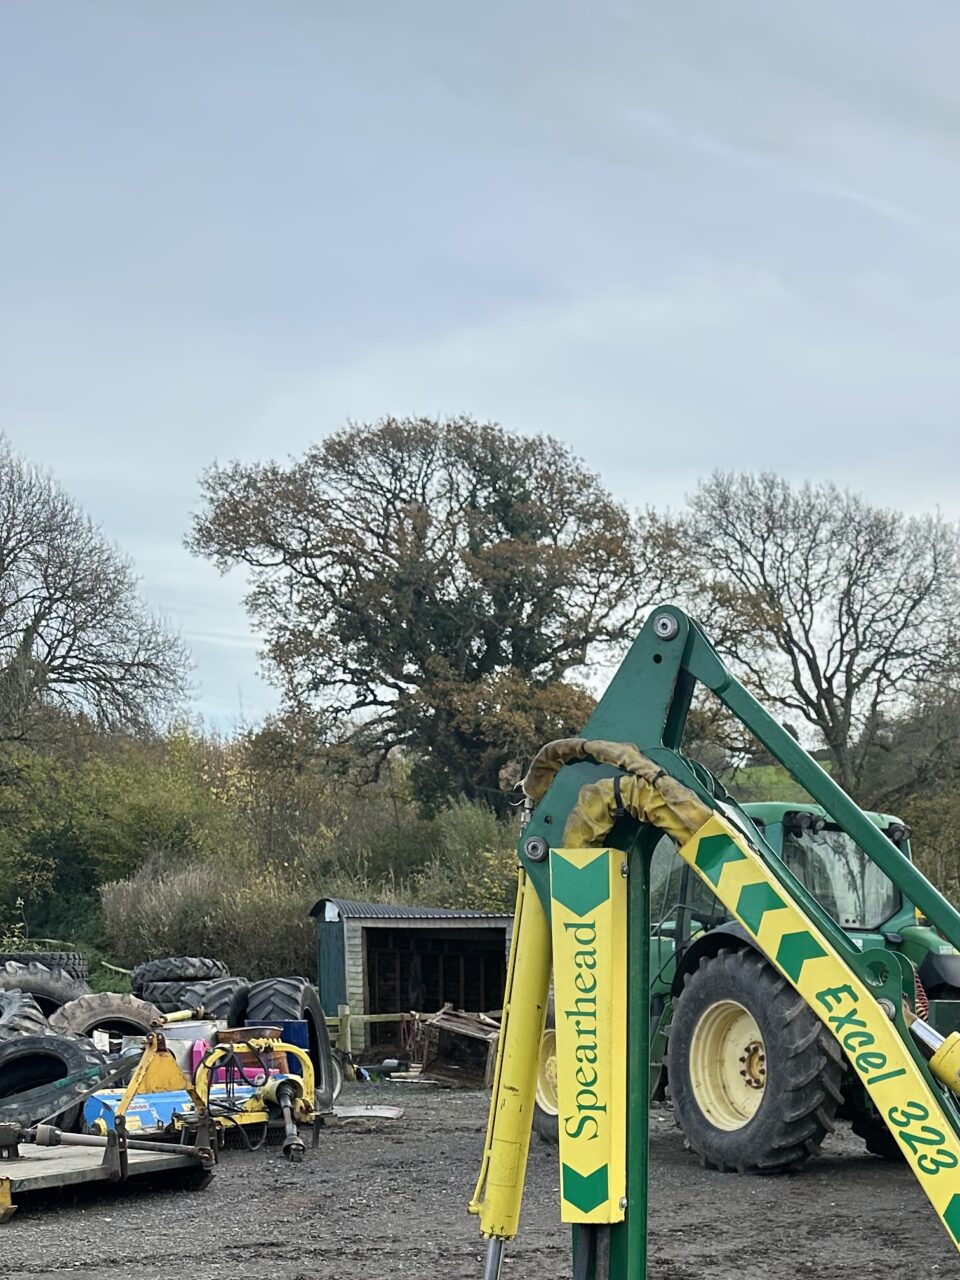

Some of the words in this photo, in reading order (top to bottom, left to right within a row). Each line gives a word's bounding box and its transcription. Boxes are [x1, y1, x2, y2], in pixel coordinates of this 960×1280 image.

[563, 919, 607, 1141] Spearhead
[815, 983, 907, 1086] Excel
[888, 1100, 958, 1176] 323
